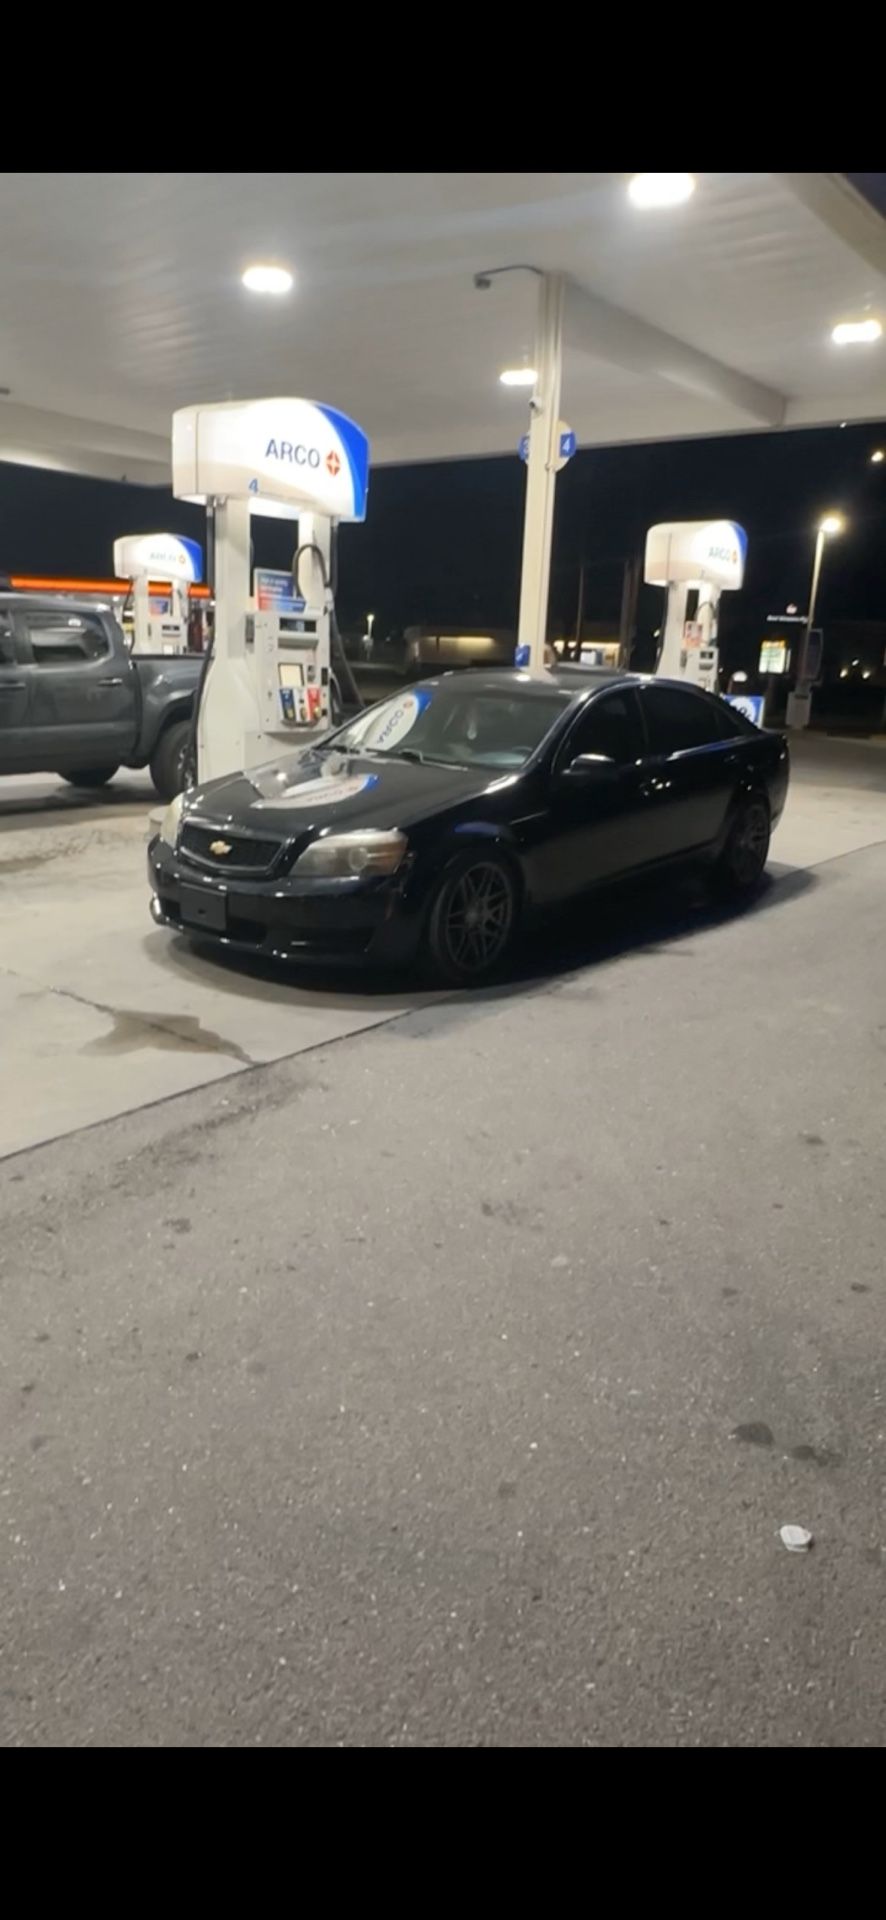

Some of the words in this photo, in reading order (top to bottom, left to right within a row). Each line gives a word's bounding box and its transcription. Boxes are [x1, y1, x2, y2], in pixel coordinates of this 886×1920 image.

[265, 438, 321, 468] ARCO
[562, 437, 571, 453] 4
[248, 478, 259, 494] 4
